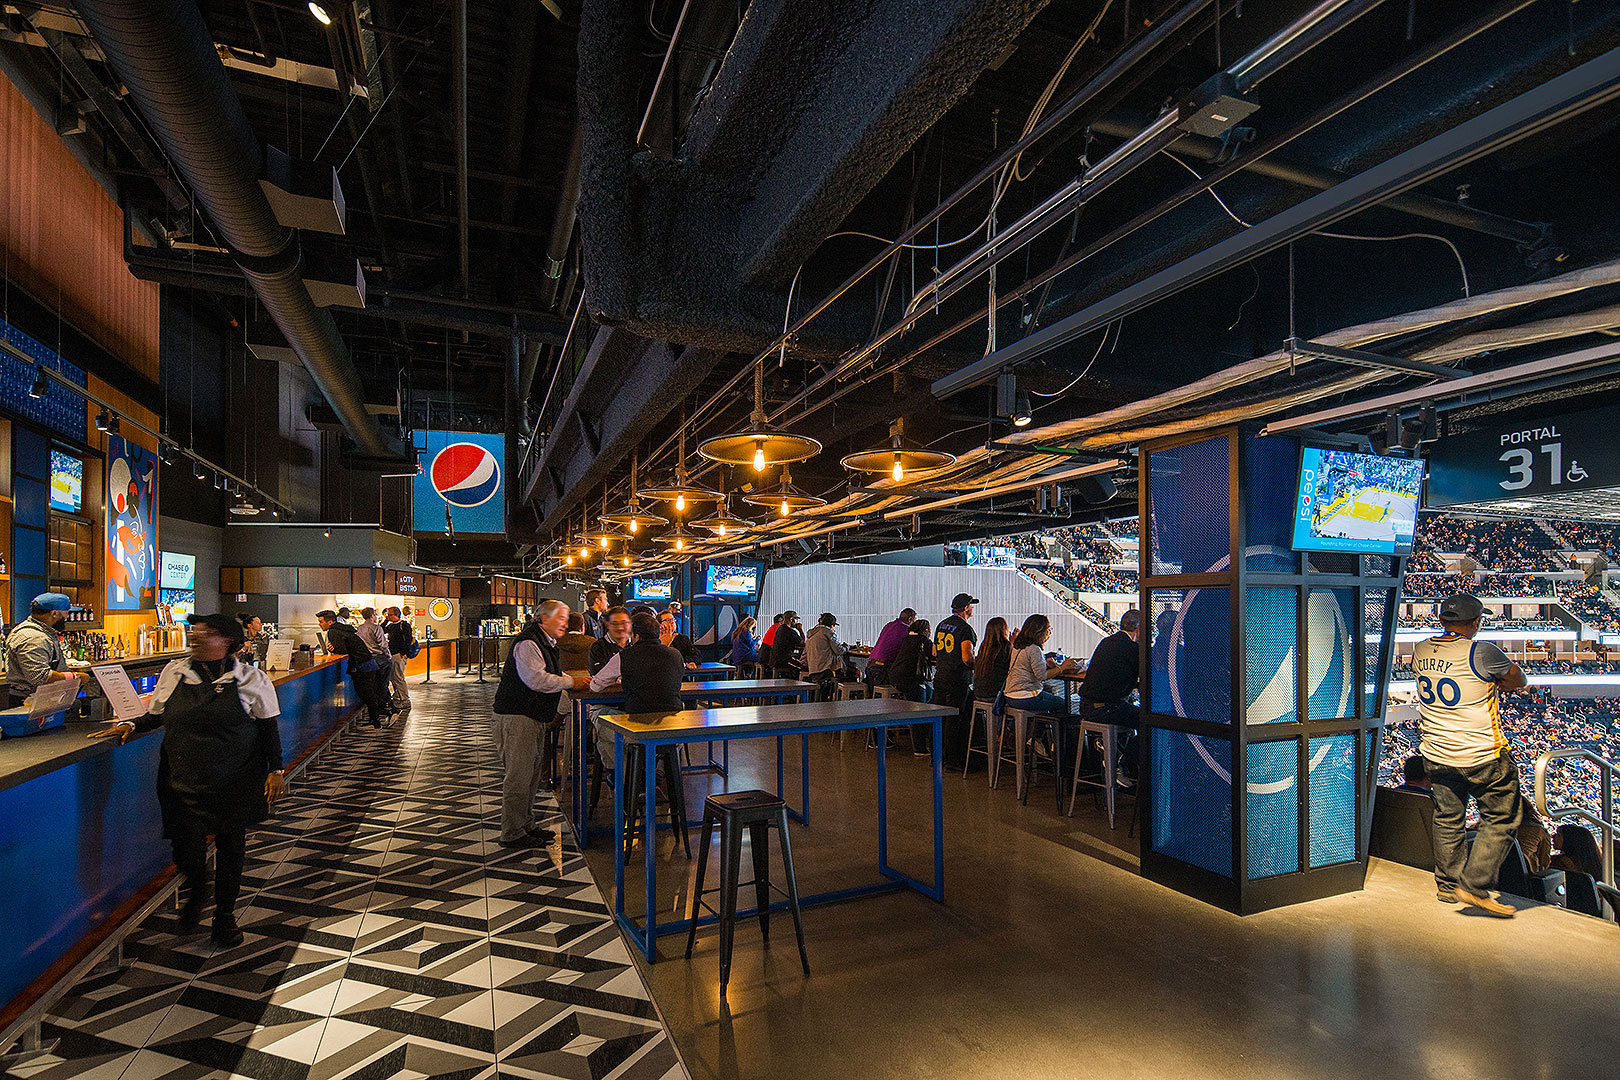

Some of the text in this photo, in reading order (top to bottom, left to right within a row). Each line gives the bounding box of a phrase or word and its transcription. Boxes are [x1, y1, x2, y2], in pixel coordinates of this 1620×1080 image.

[1500, 426, 1561, 446] PORTAL
[1499, 442, 1562, 491] 31
[1301, 469, 1315, 521] pepsi
[168, 563, 184, 572] CHASE
[170, 571, 186, 579] CENTER
[402, 575, 415, 583] CITY
[399, 584, 418, 593] BISTRO
[936, 631, 955, 654] 30
[1418, 658, 1453, 674] CURRY
[1417, 675, 1461, 707] 30
